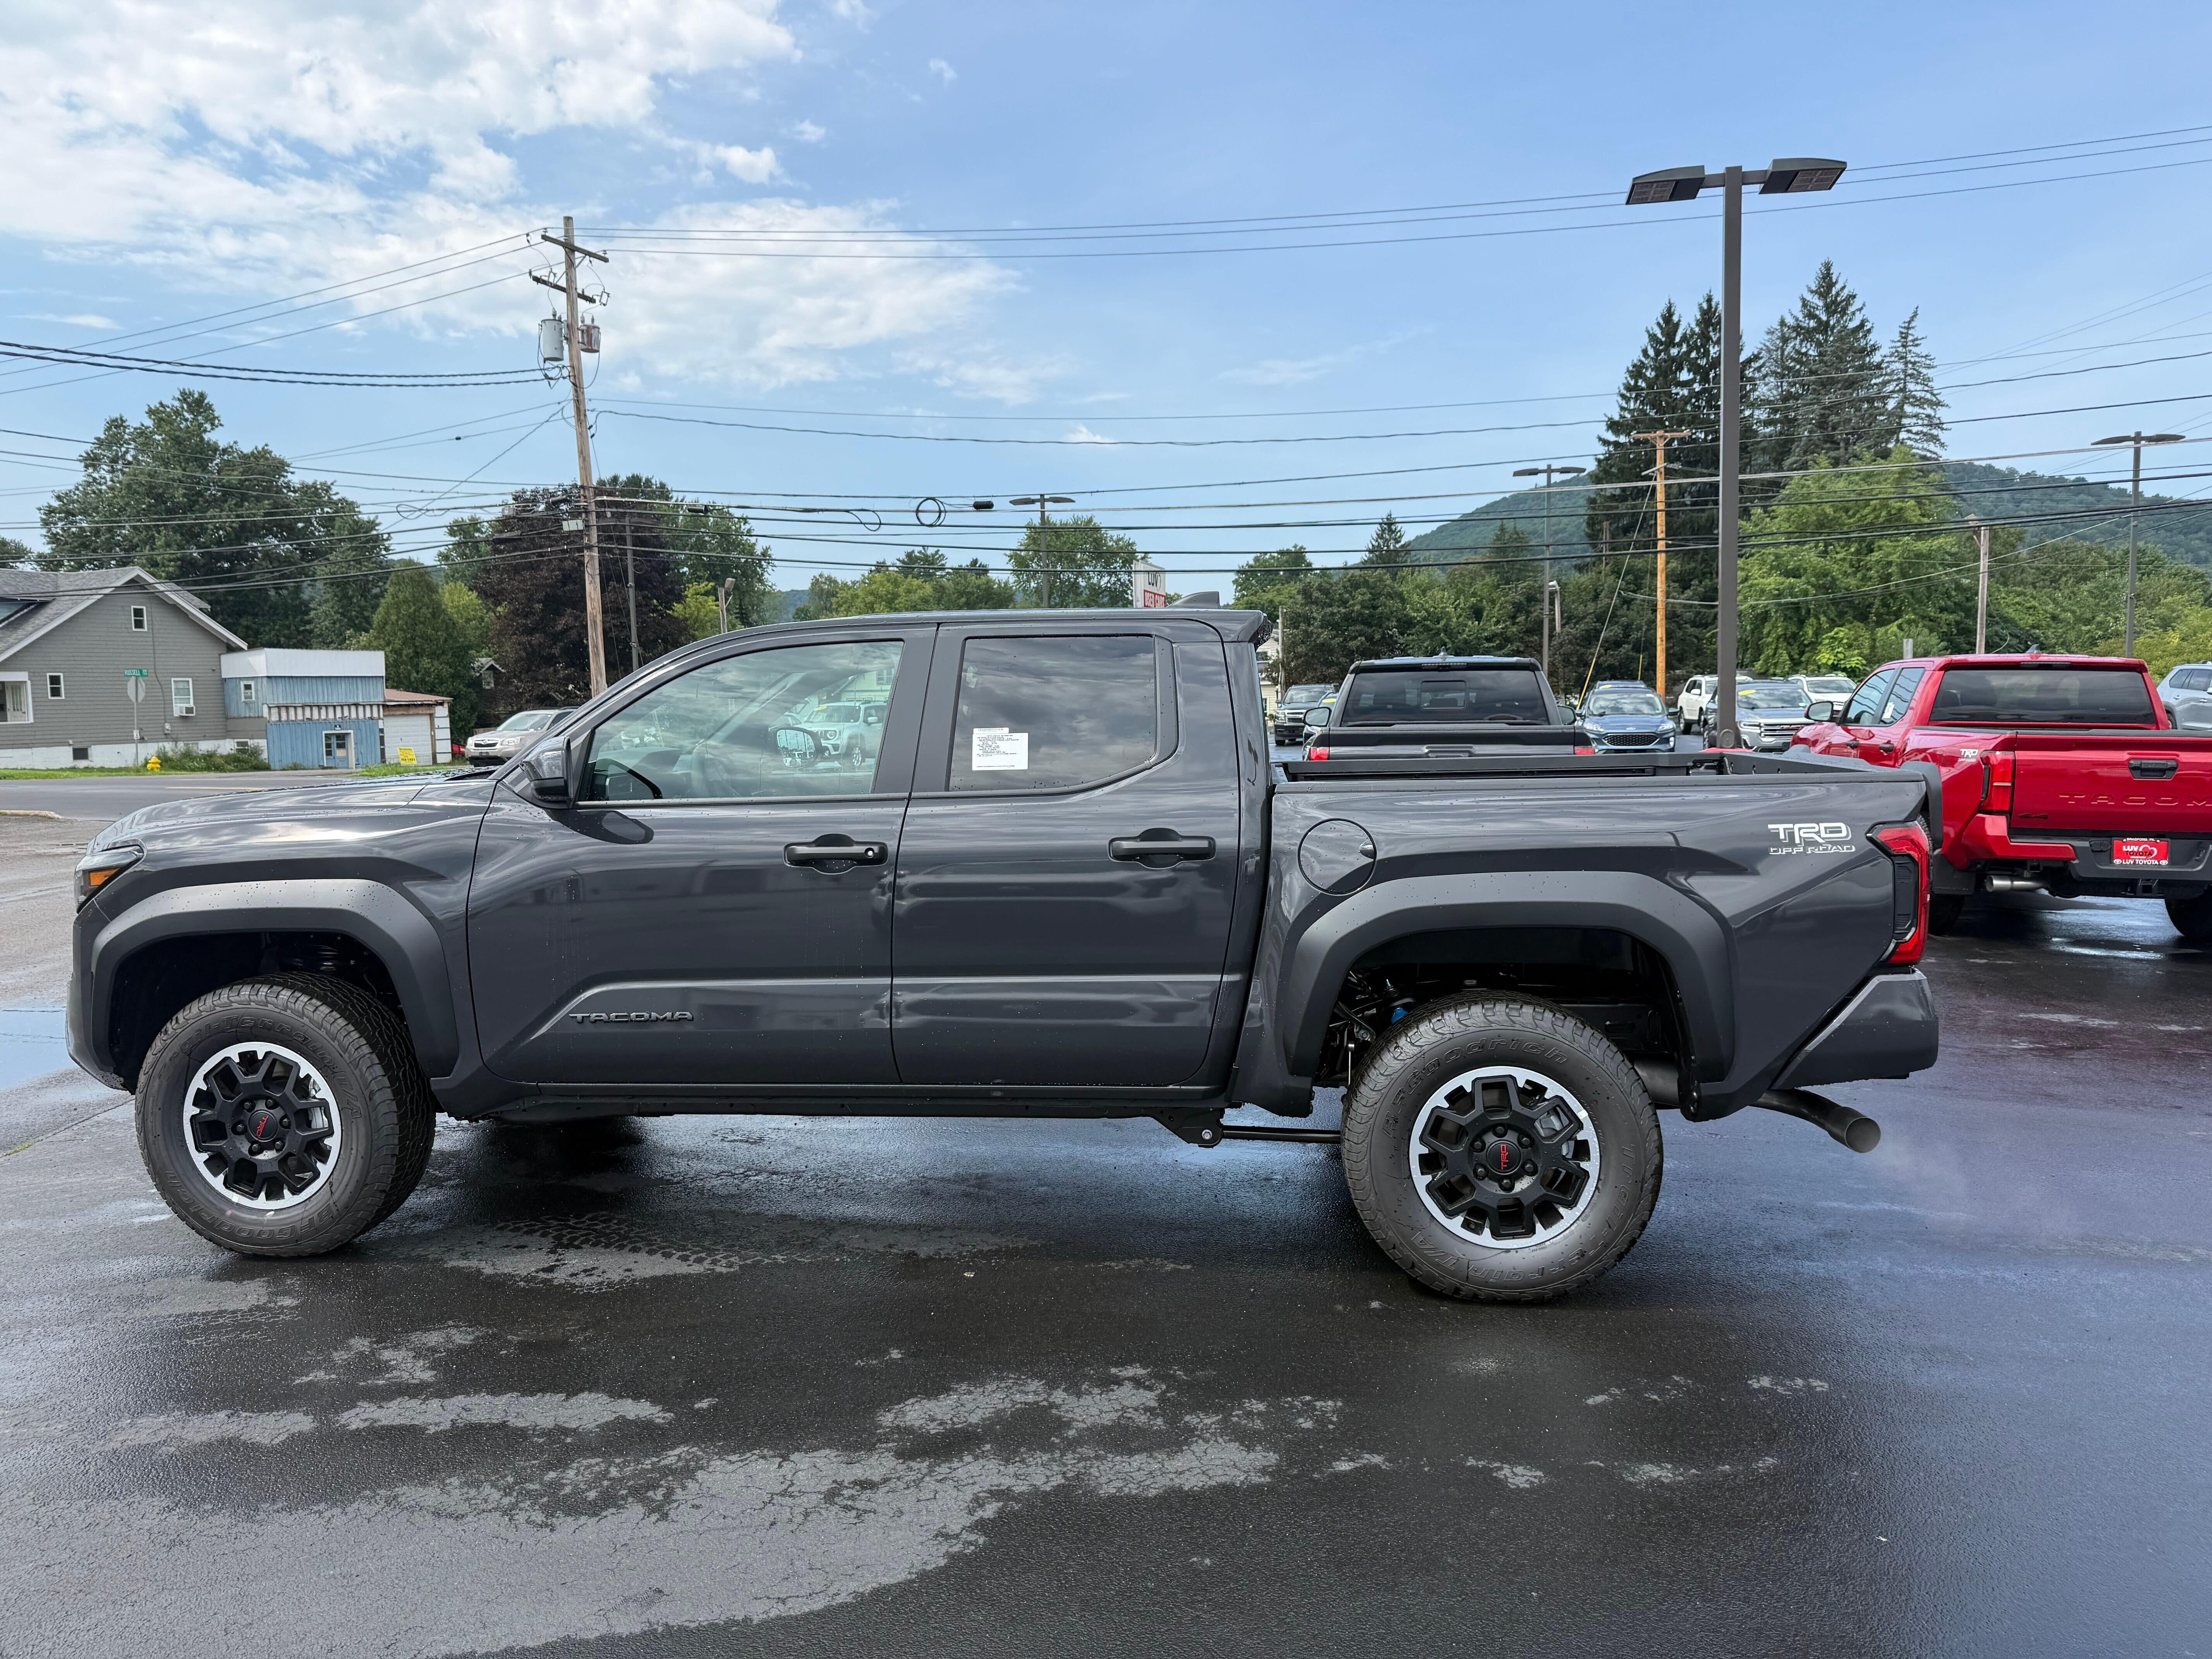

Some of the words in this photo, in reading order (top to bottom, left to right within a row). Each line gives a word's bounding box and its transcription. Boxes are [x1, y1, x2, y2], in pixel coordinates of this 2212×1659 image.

[1148, 572, 1158, 587] LUV
[1145, 591, 1154, 607] USED
[1155, 594, 1164, 607] CARS
[1960, 749, 1978, 757] TRD
[1768, 823, 1851, 846] TRD
[1807, 845, 1856, 854] ROAD
[569, 1012, 694, 1023] TACOMA
[1381, 1038, 1568, 1138] BFGoodrich
[256, 1115, 270, 1138] TRD
[1501, 1144, 1509, 1170] TRD
